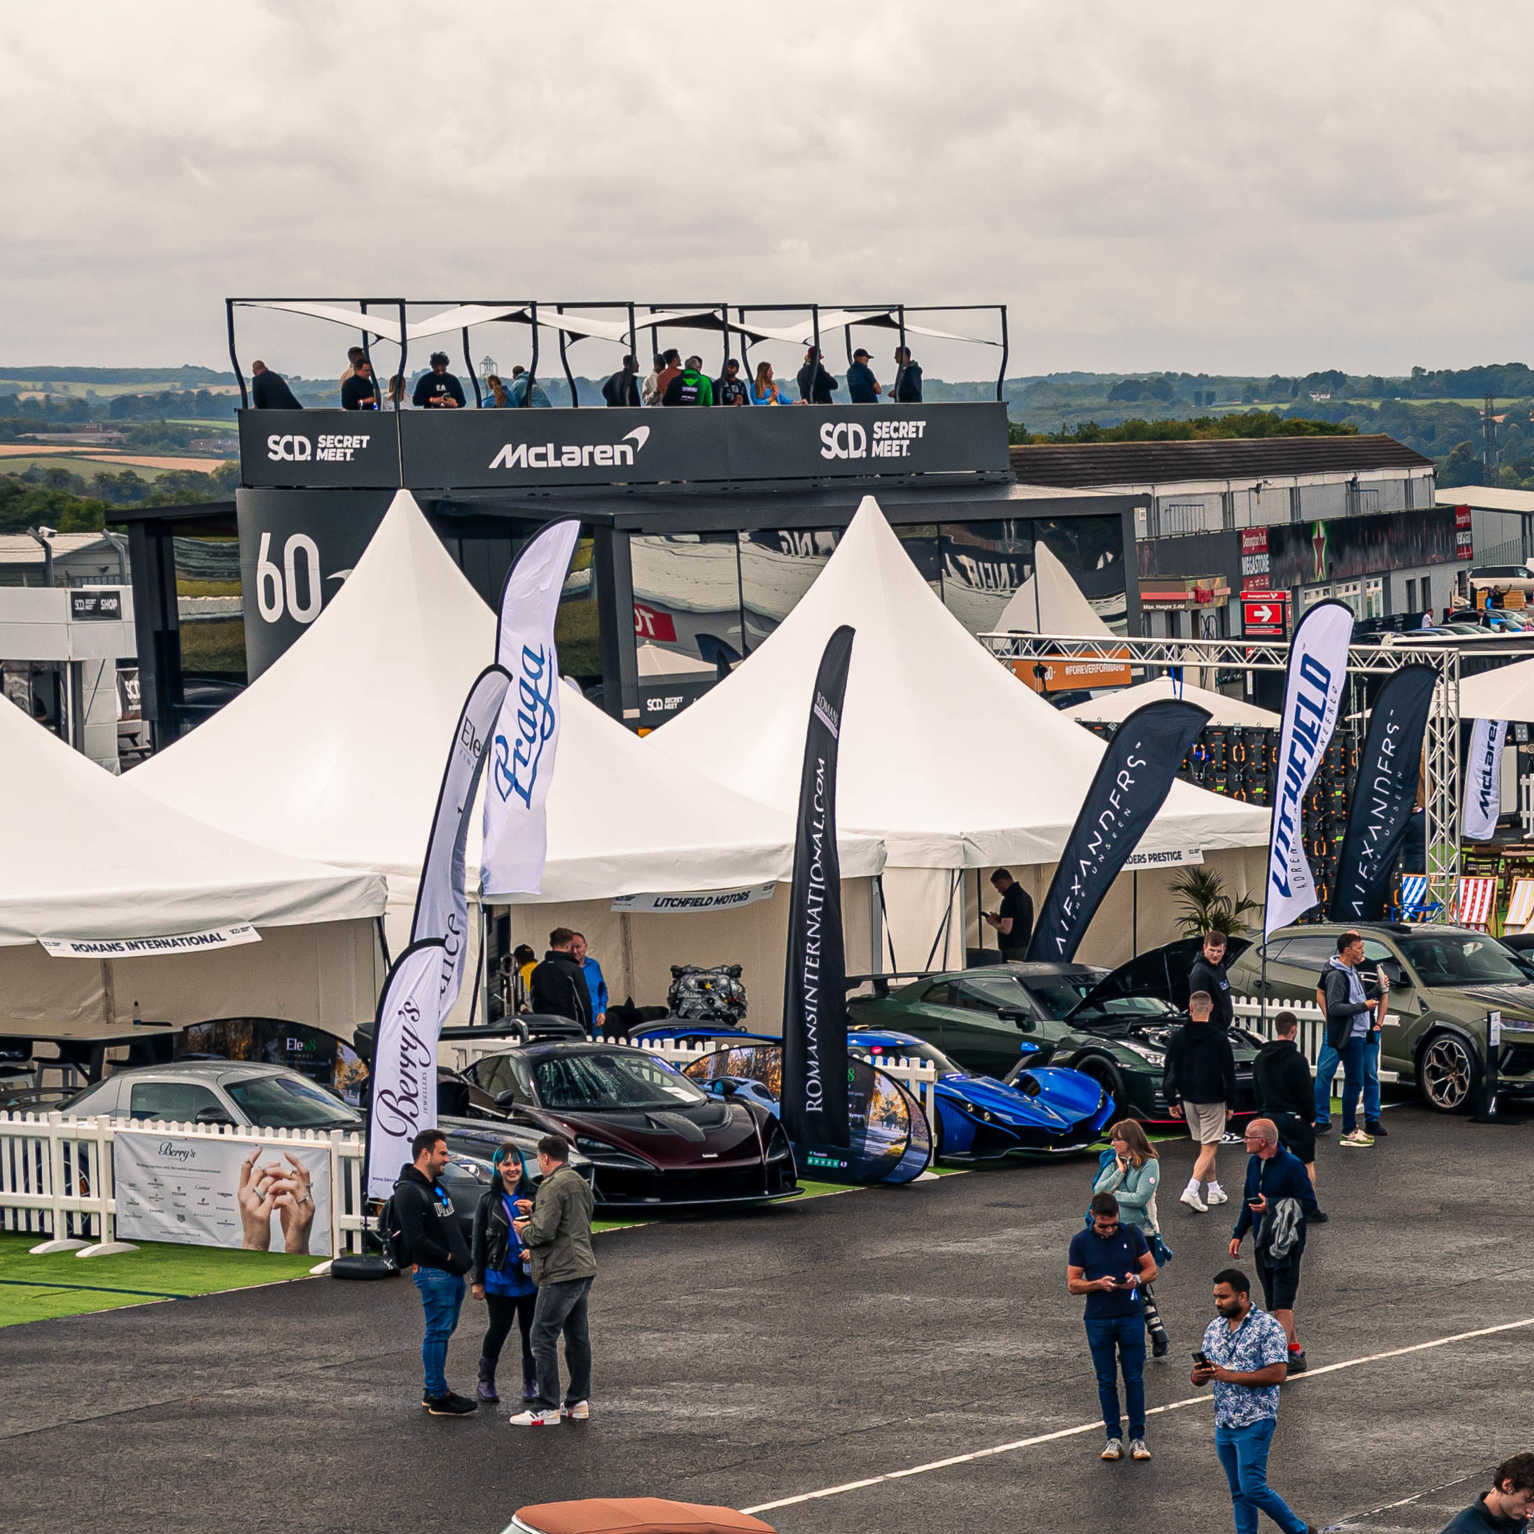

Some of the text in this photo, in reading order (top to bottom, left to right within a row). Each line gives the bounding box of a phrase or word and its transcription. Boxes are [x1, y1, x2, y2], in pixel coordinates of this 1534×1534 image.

[873, 420, 926, 439] SECRET
[317, 434, 370, 449] SECRET
[488, 443, 634, 469] McLaren
[256, 532, 322, 624] 60
[100, 599, 117, 611] SHOP
[1147, 850, 1183, 866] PRESTIGE
[652, 889, 753, 910] LITCHFIELD MOTORS
[72, 932, 226, 955] ROMANS INTERNATIONAL
[803, 756, 831, 1115] ROMANSINTERNATIONAL.COM
[376, 1000, 432, 1142] Berry's
[158, 1141, 196, 1162] Berry's
